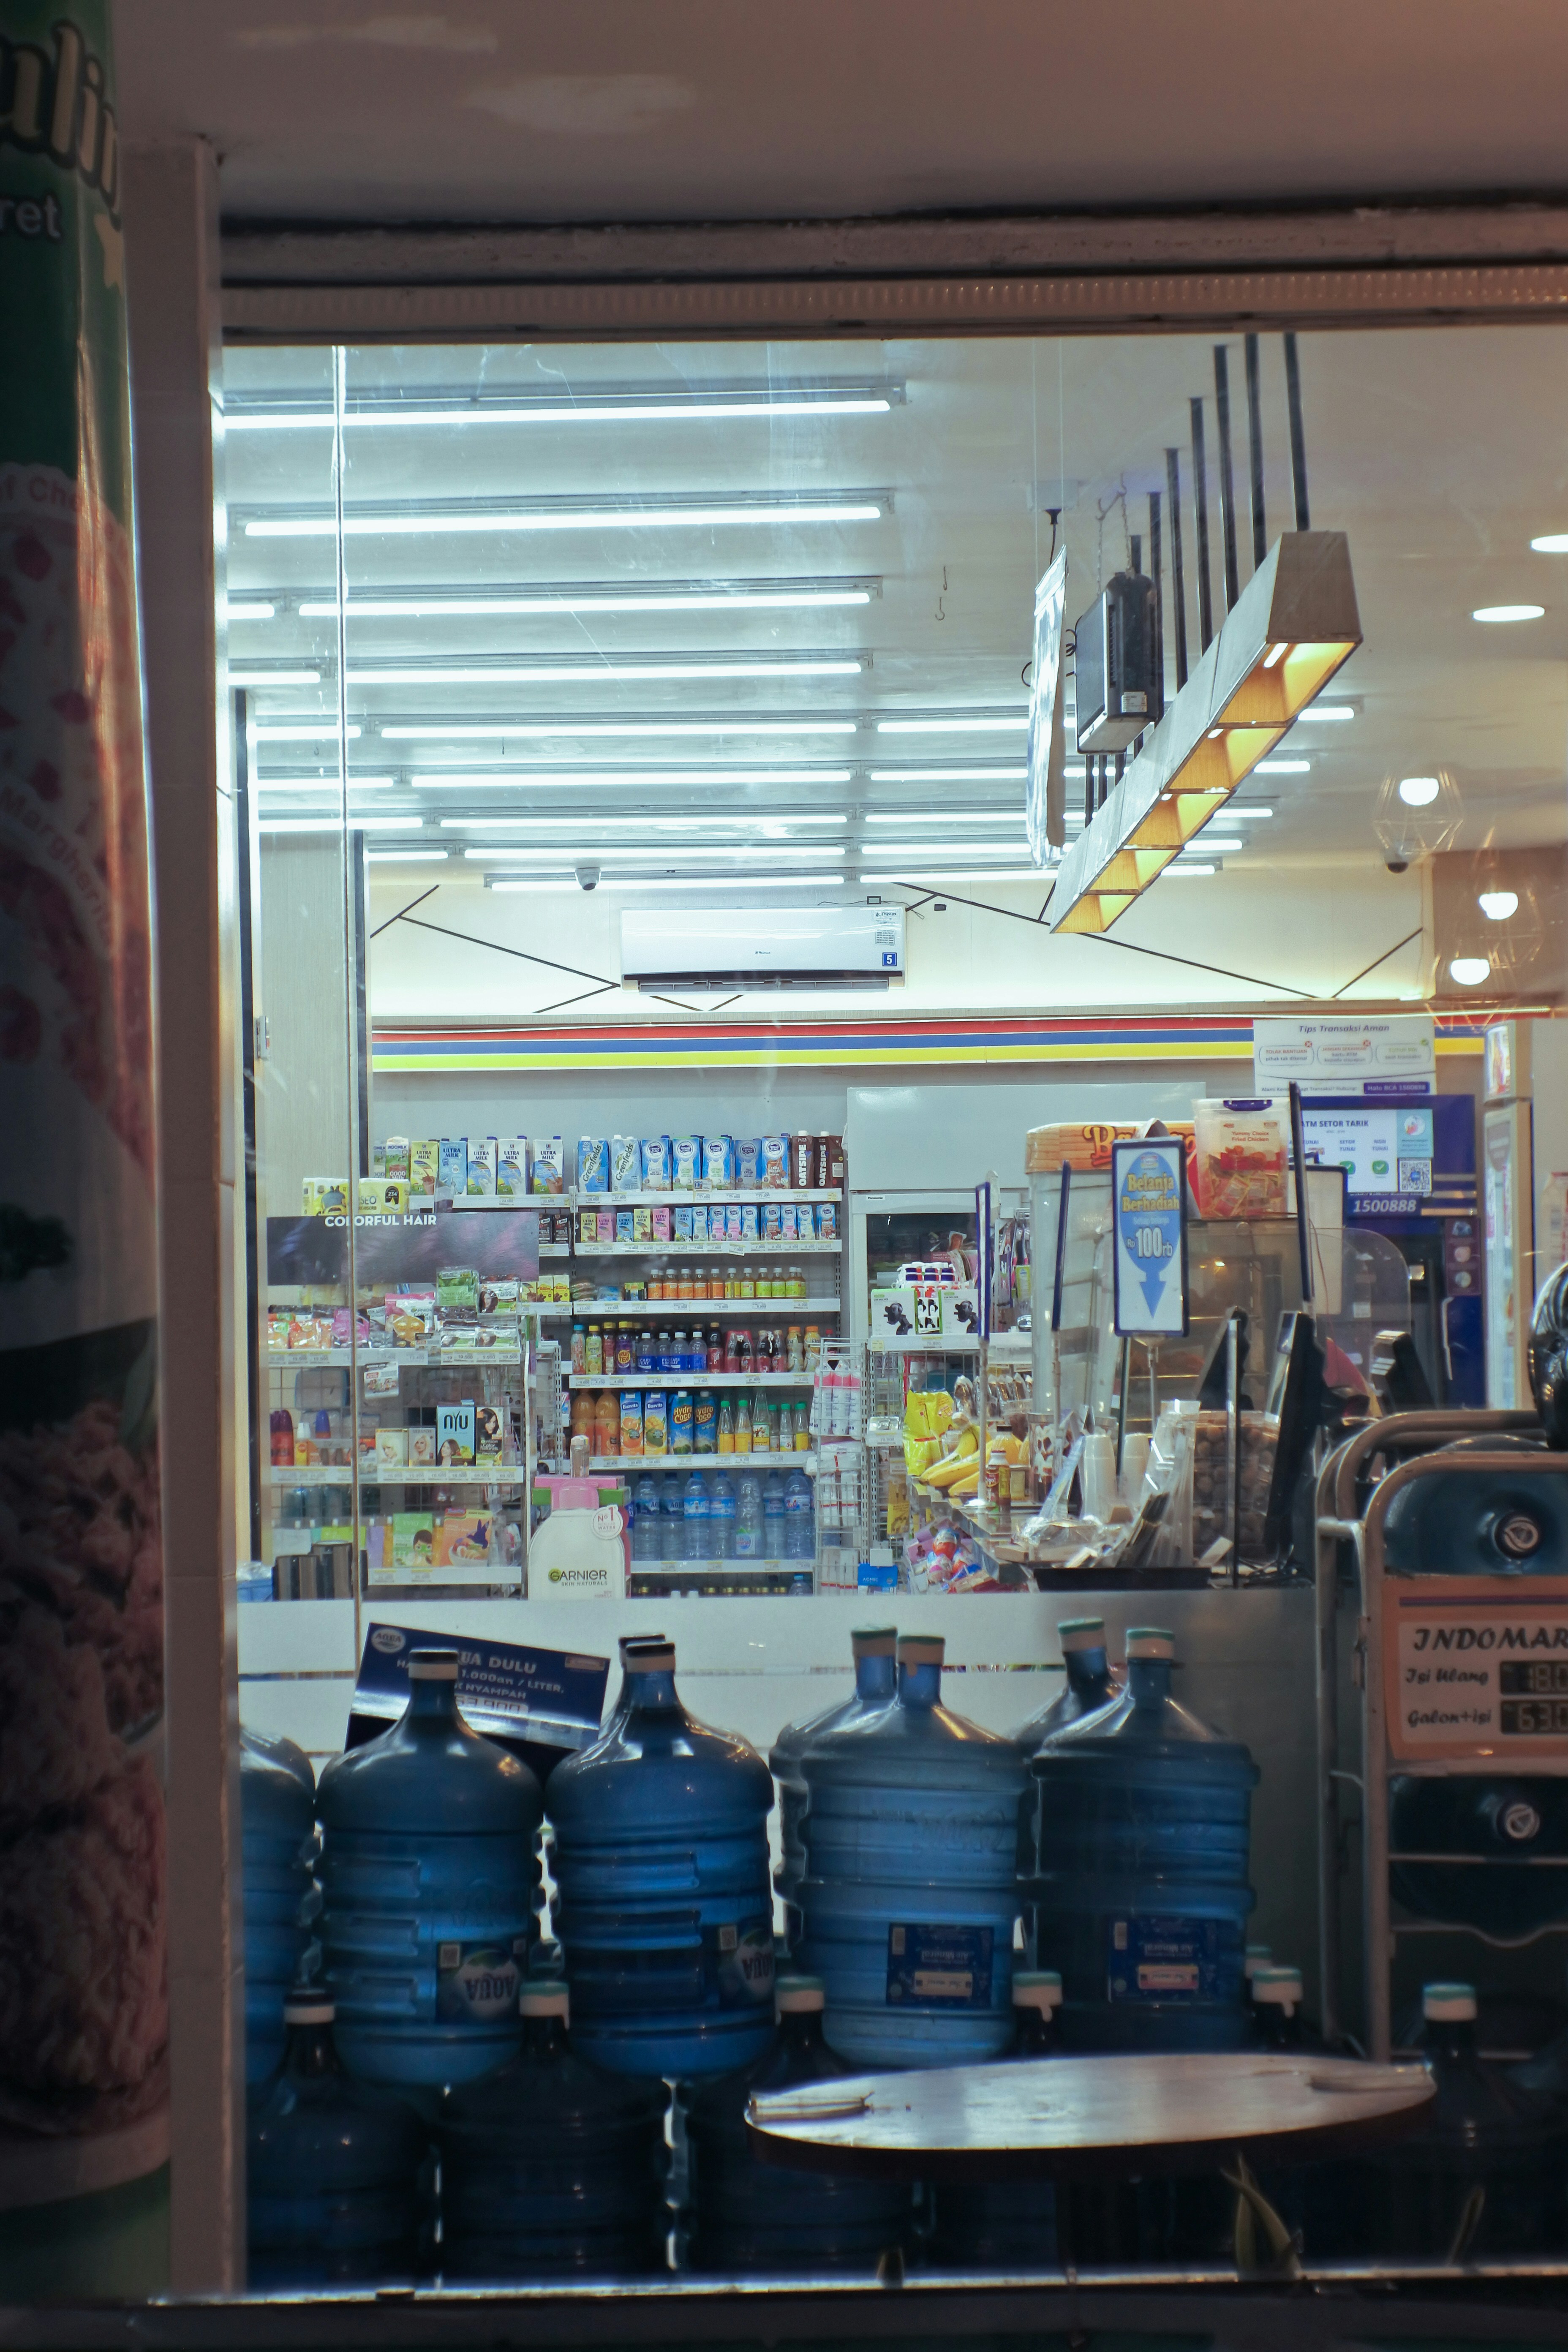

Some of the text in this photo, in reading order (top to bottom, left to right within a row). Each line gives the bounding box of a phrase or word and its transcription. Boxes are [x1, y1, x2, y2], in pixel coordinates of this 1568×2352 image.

[887, 955, 892, 964] 5
[583, 1144, 602, 1182] Greenfields
[615, 1143, 634, 1181] Greenfields
[798, 1144, 807, 1186] OATSIDE
[1127, 1172, 1174, 1195] Belanja
[1122, 1195, 1179, 1212] Berhadiah
[1353, 1199, 1417, 1213] 1500888
[403, 1215, 437, 1225] HAIR
[674, 1406, 692, 1415] Hydro
[674, 1413, 691, 1424] Coco
[550, 1569, 607, 1581] GARNIER
[489, 1656, 536, 1674] DULU
[1436, 1669, 1489, 1686] Ulang
[466, 1684, 526, 1700] NYAMPAH
